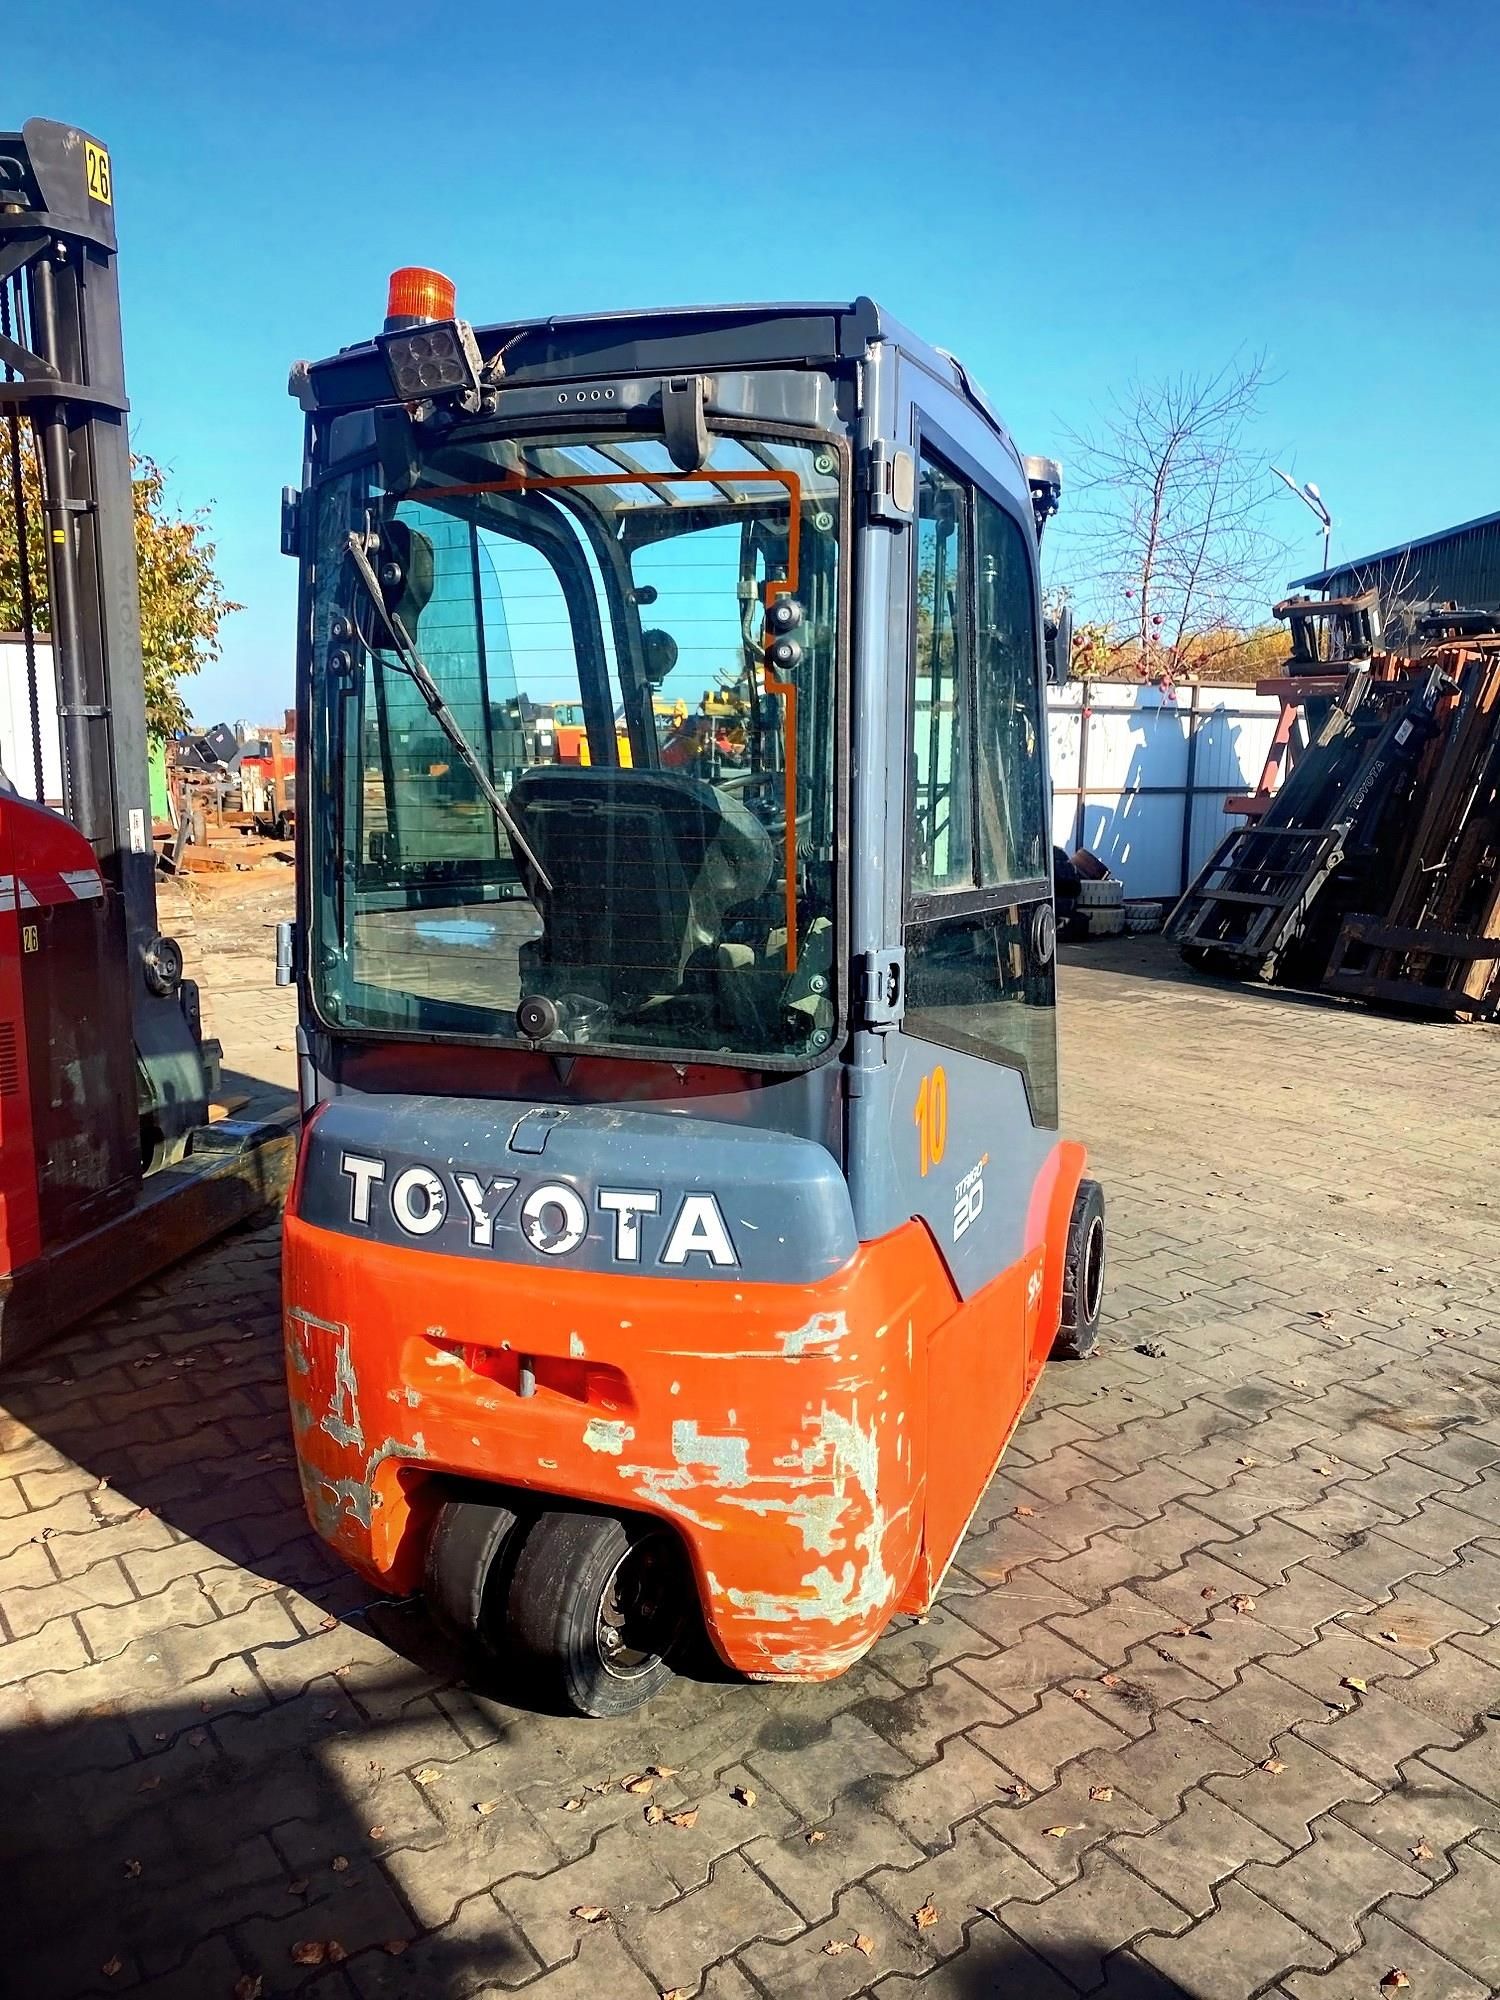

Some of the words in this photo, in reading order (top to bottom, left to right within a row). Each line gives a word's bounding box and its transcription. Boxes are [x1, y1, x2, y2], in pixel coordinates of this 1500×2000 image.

[89, 149, 108, 199] 26
[1350, 761, 1385, 810] TOYOTA
[25, 928, 36, 951] 26
[914, 1065, 947, 1177] 10
[341, 1155, 738, 1266] TOYOTA
[953, 1178, 983, 1243] 20
